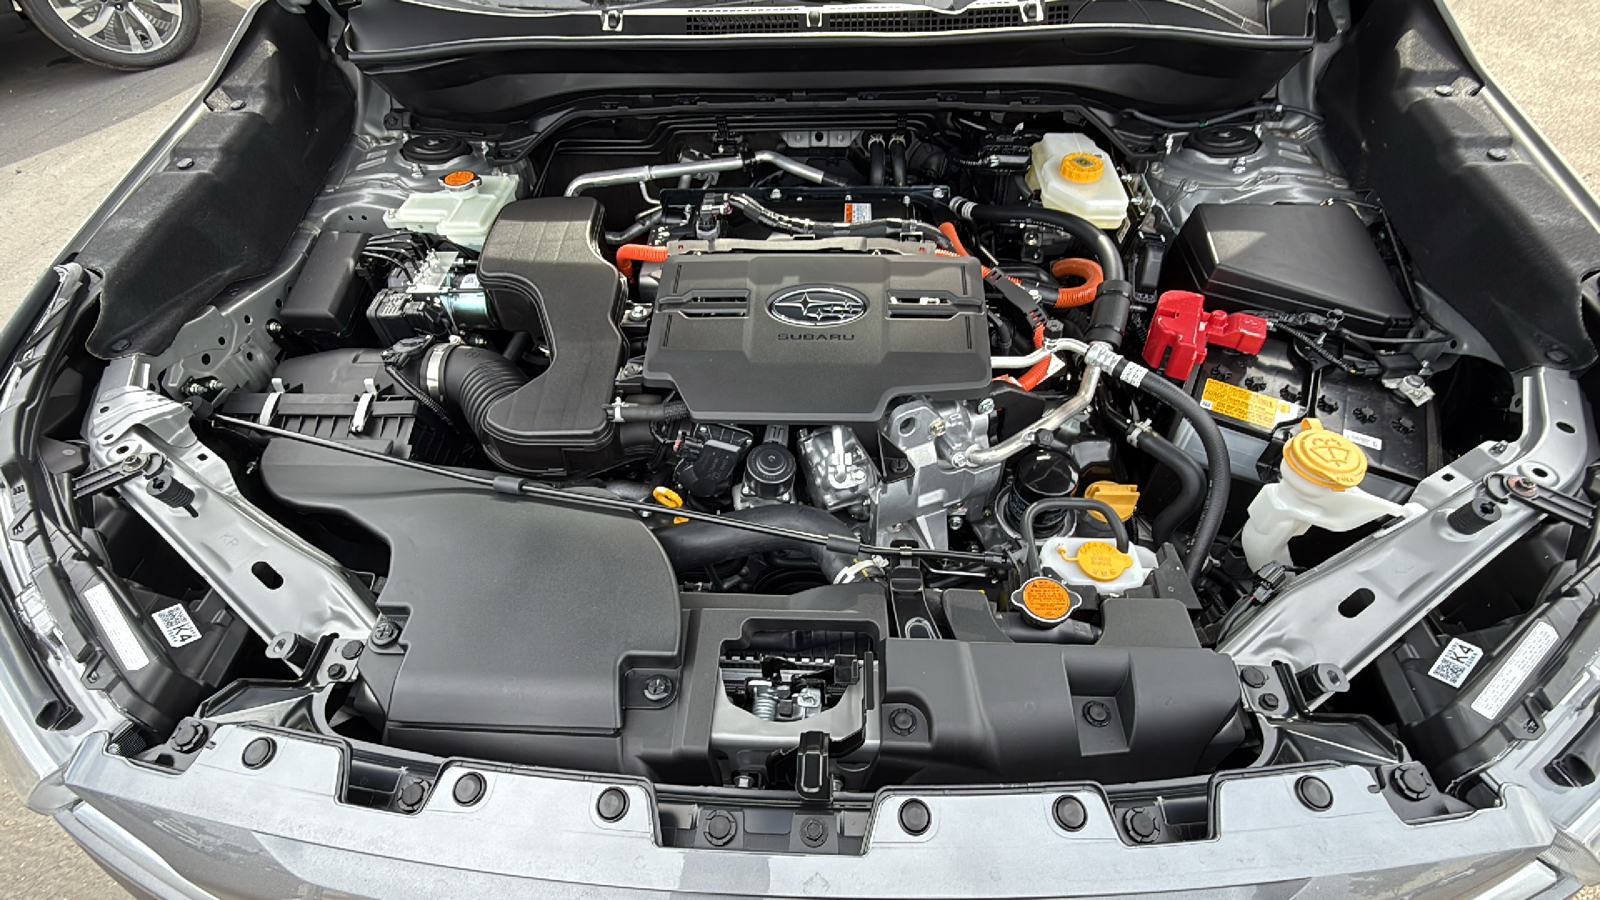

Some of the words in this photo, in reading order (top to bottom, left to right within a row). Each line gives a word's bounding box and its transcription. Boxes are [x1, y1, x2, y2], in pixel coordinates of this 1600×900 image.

[778, 333, 855, 341] SUBARU
[172, 621, 193, 643] K4
[1450, 644, 1474, 664] K4
